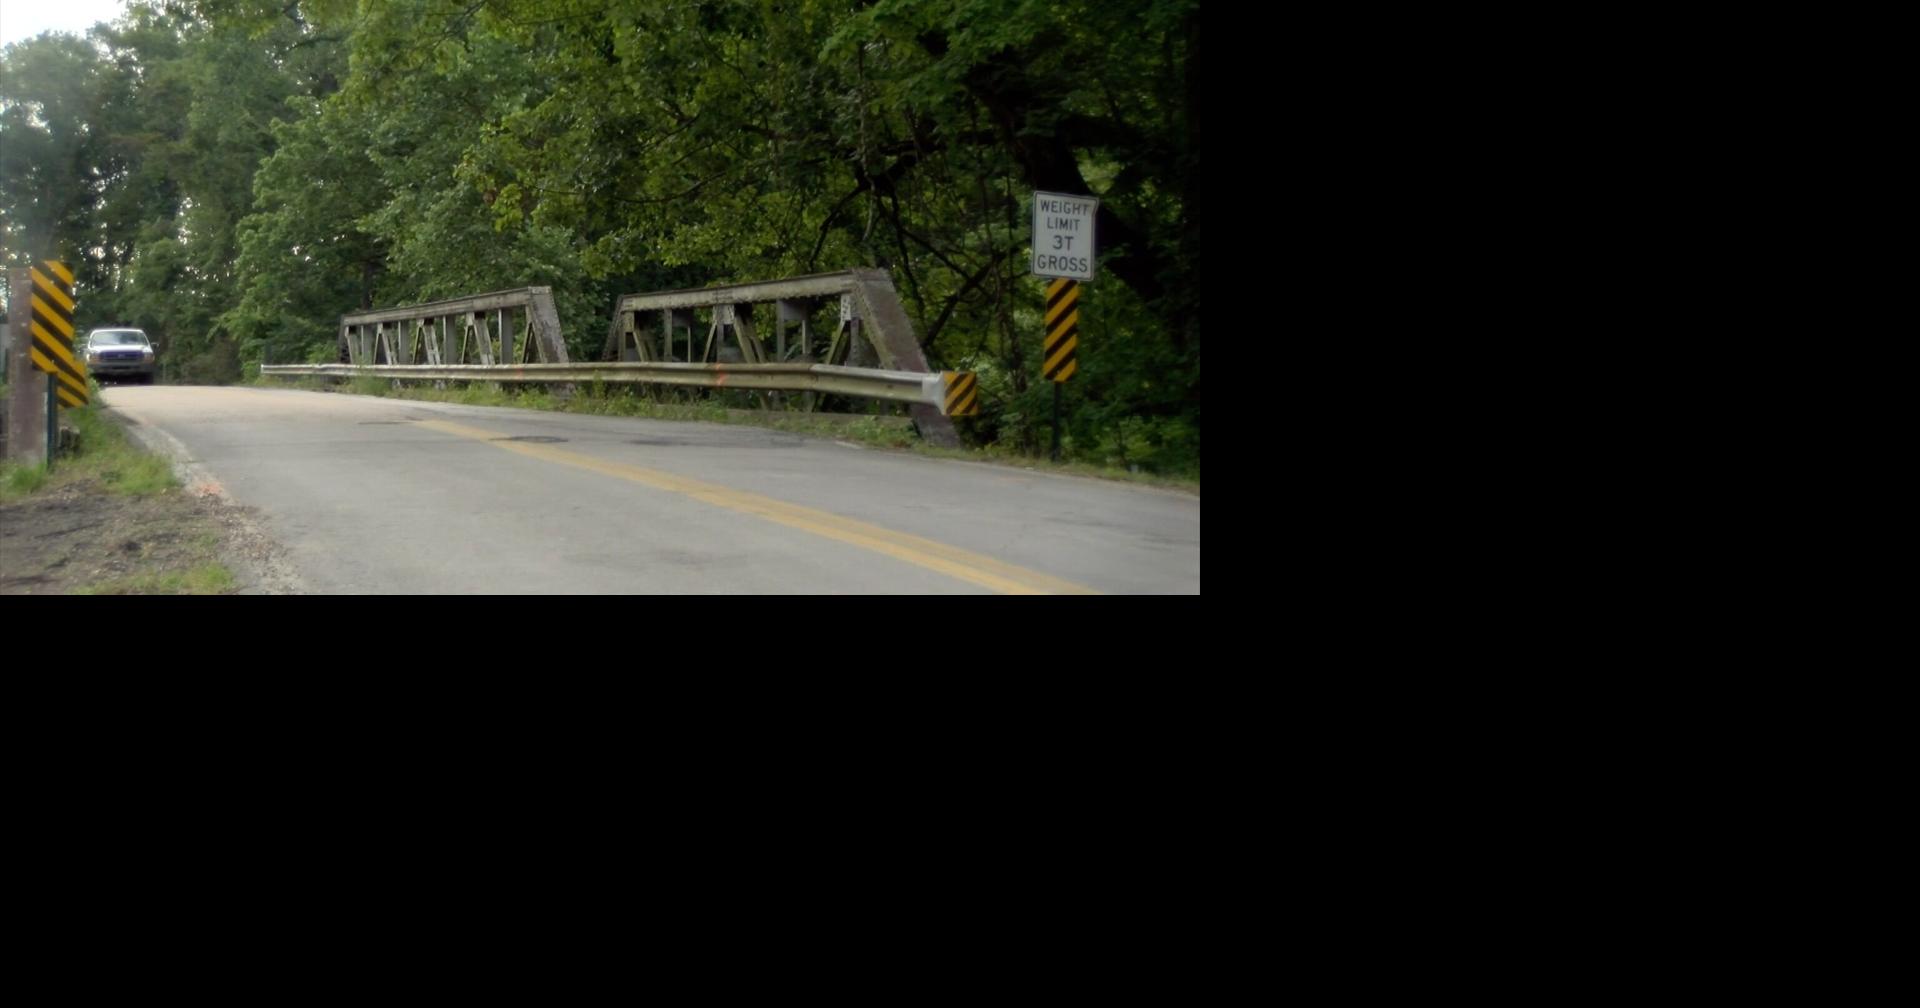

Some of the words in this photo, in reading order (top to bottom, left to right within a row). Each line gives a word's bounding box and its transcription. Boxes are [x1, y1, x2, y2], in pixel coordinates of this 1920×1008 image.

[1040, 200, 1089, 216] WEIGHT
[1047, 217, 1080, 231] LIMIT
[1052, 235, 1074, 251] 3T
[1037, 254, 1088, 273] GROSS
